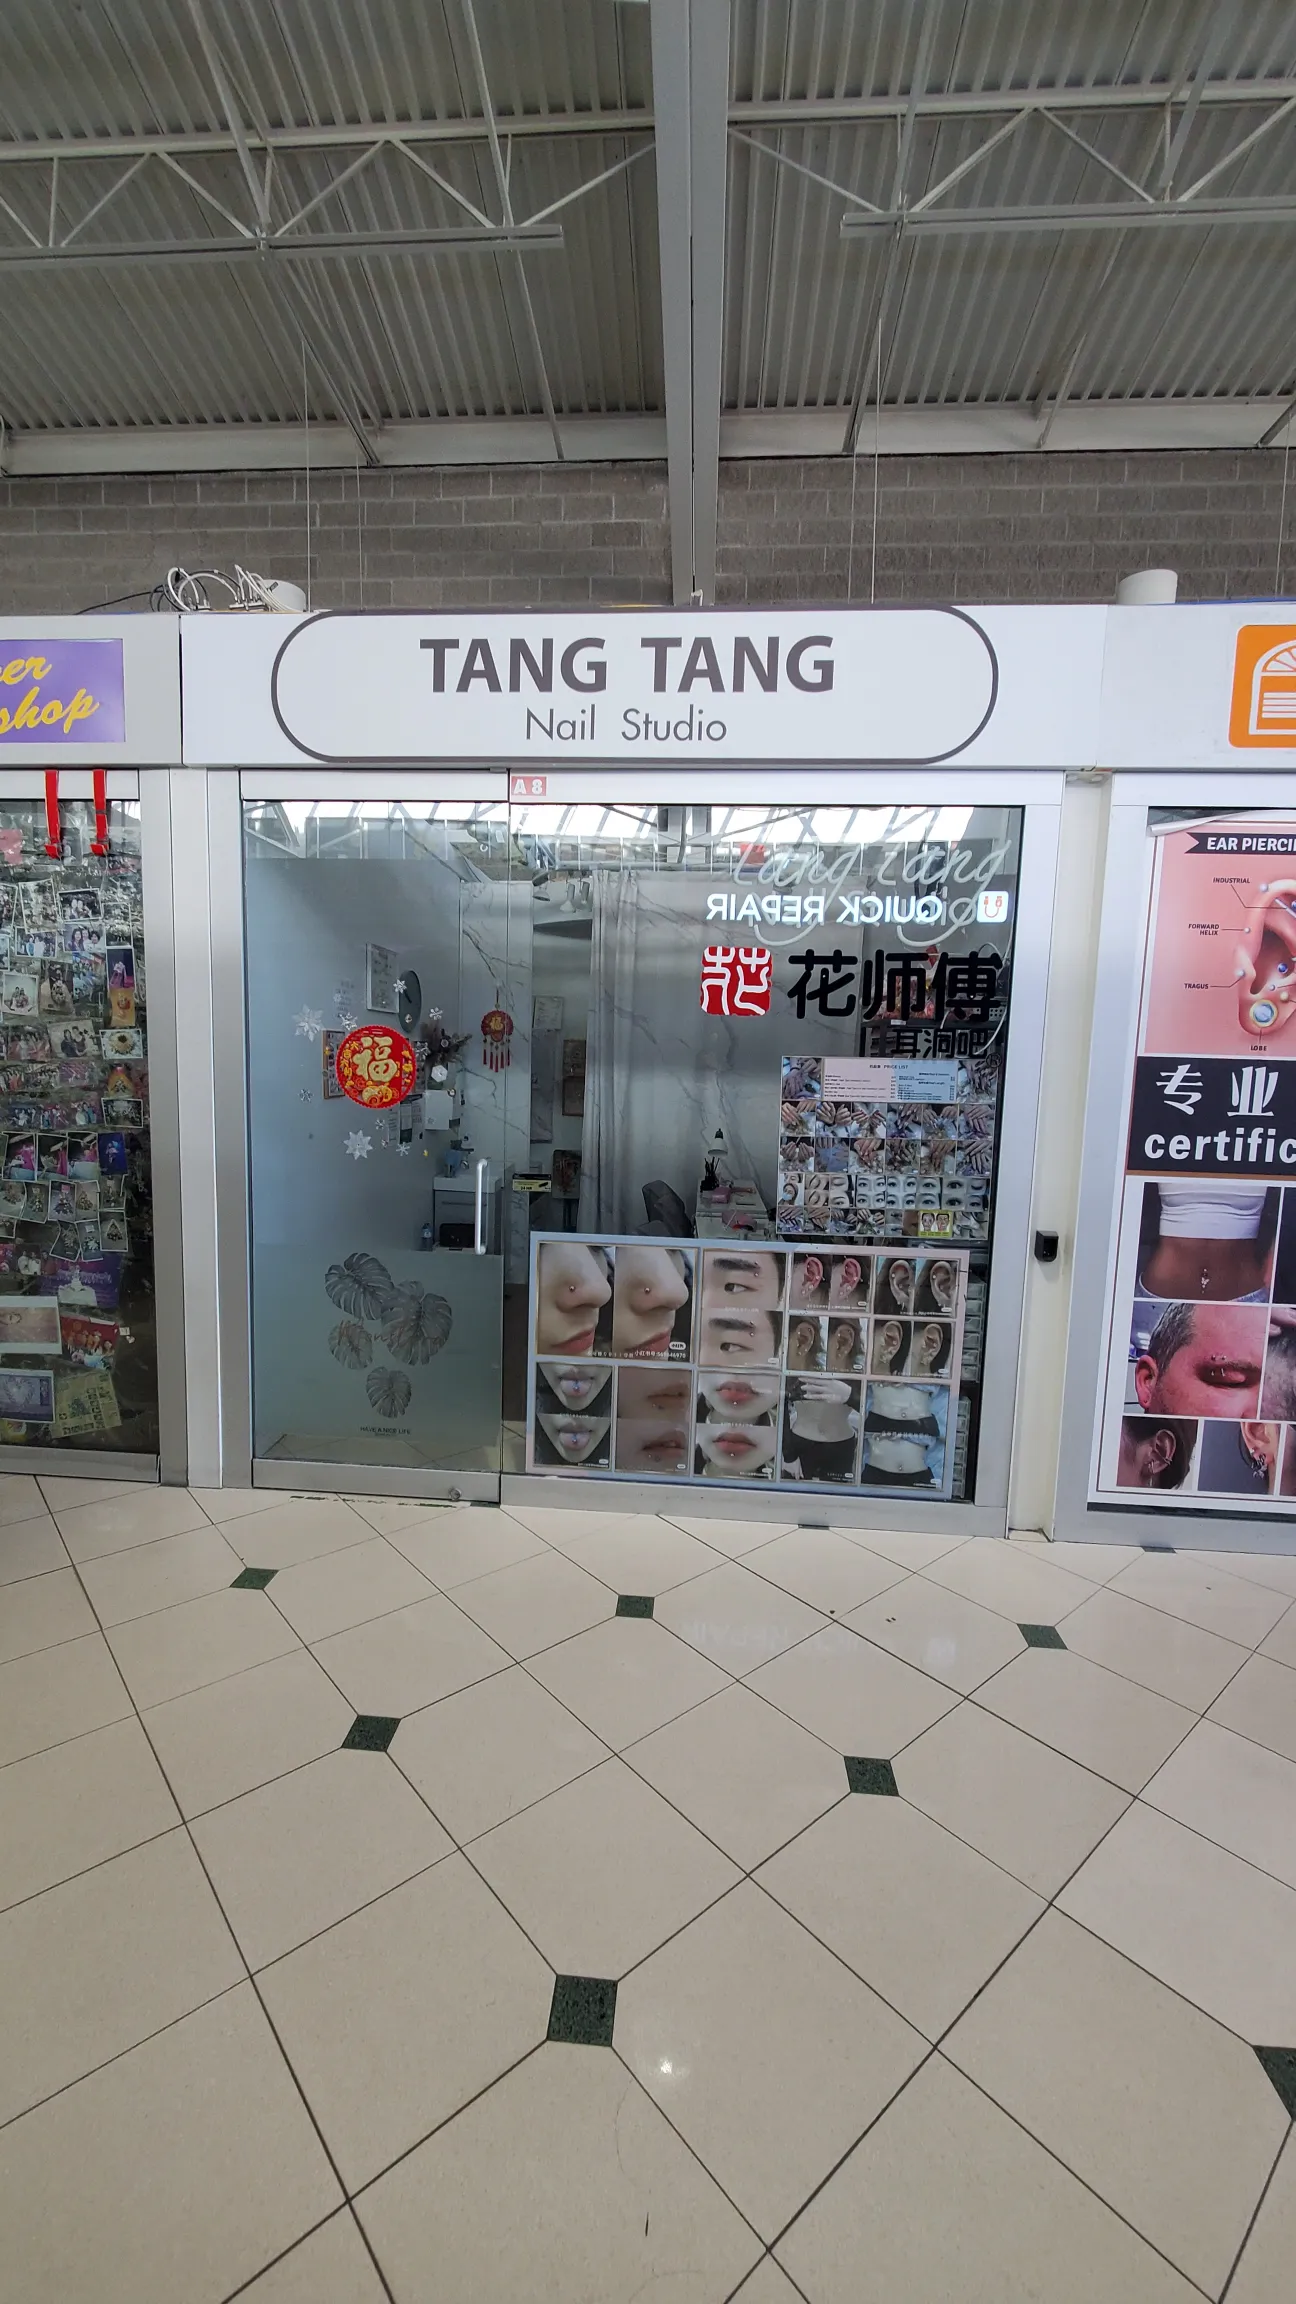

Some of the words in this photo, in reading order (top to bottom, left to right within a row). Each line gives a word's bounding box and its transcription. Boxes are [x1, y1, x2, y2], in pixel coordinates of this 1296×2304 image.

[419, 637, 607, 694] TANG
[640, 635, 834, 694] TANG
[525, 704, 596, 741] Nail
[620, 704, 727, 742] Studio
[1206, 837, 1238, 851] EAR
[787, 949, 1003, 1022] 花师傅
[352, 1036, 398, 1083] 福
[1250, 1044, 1268, 1052] LOBE
[1155, 1063, 1280, 1118] 专业
